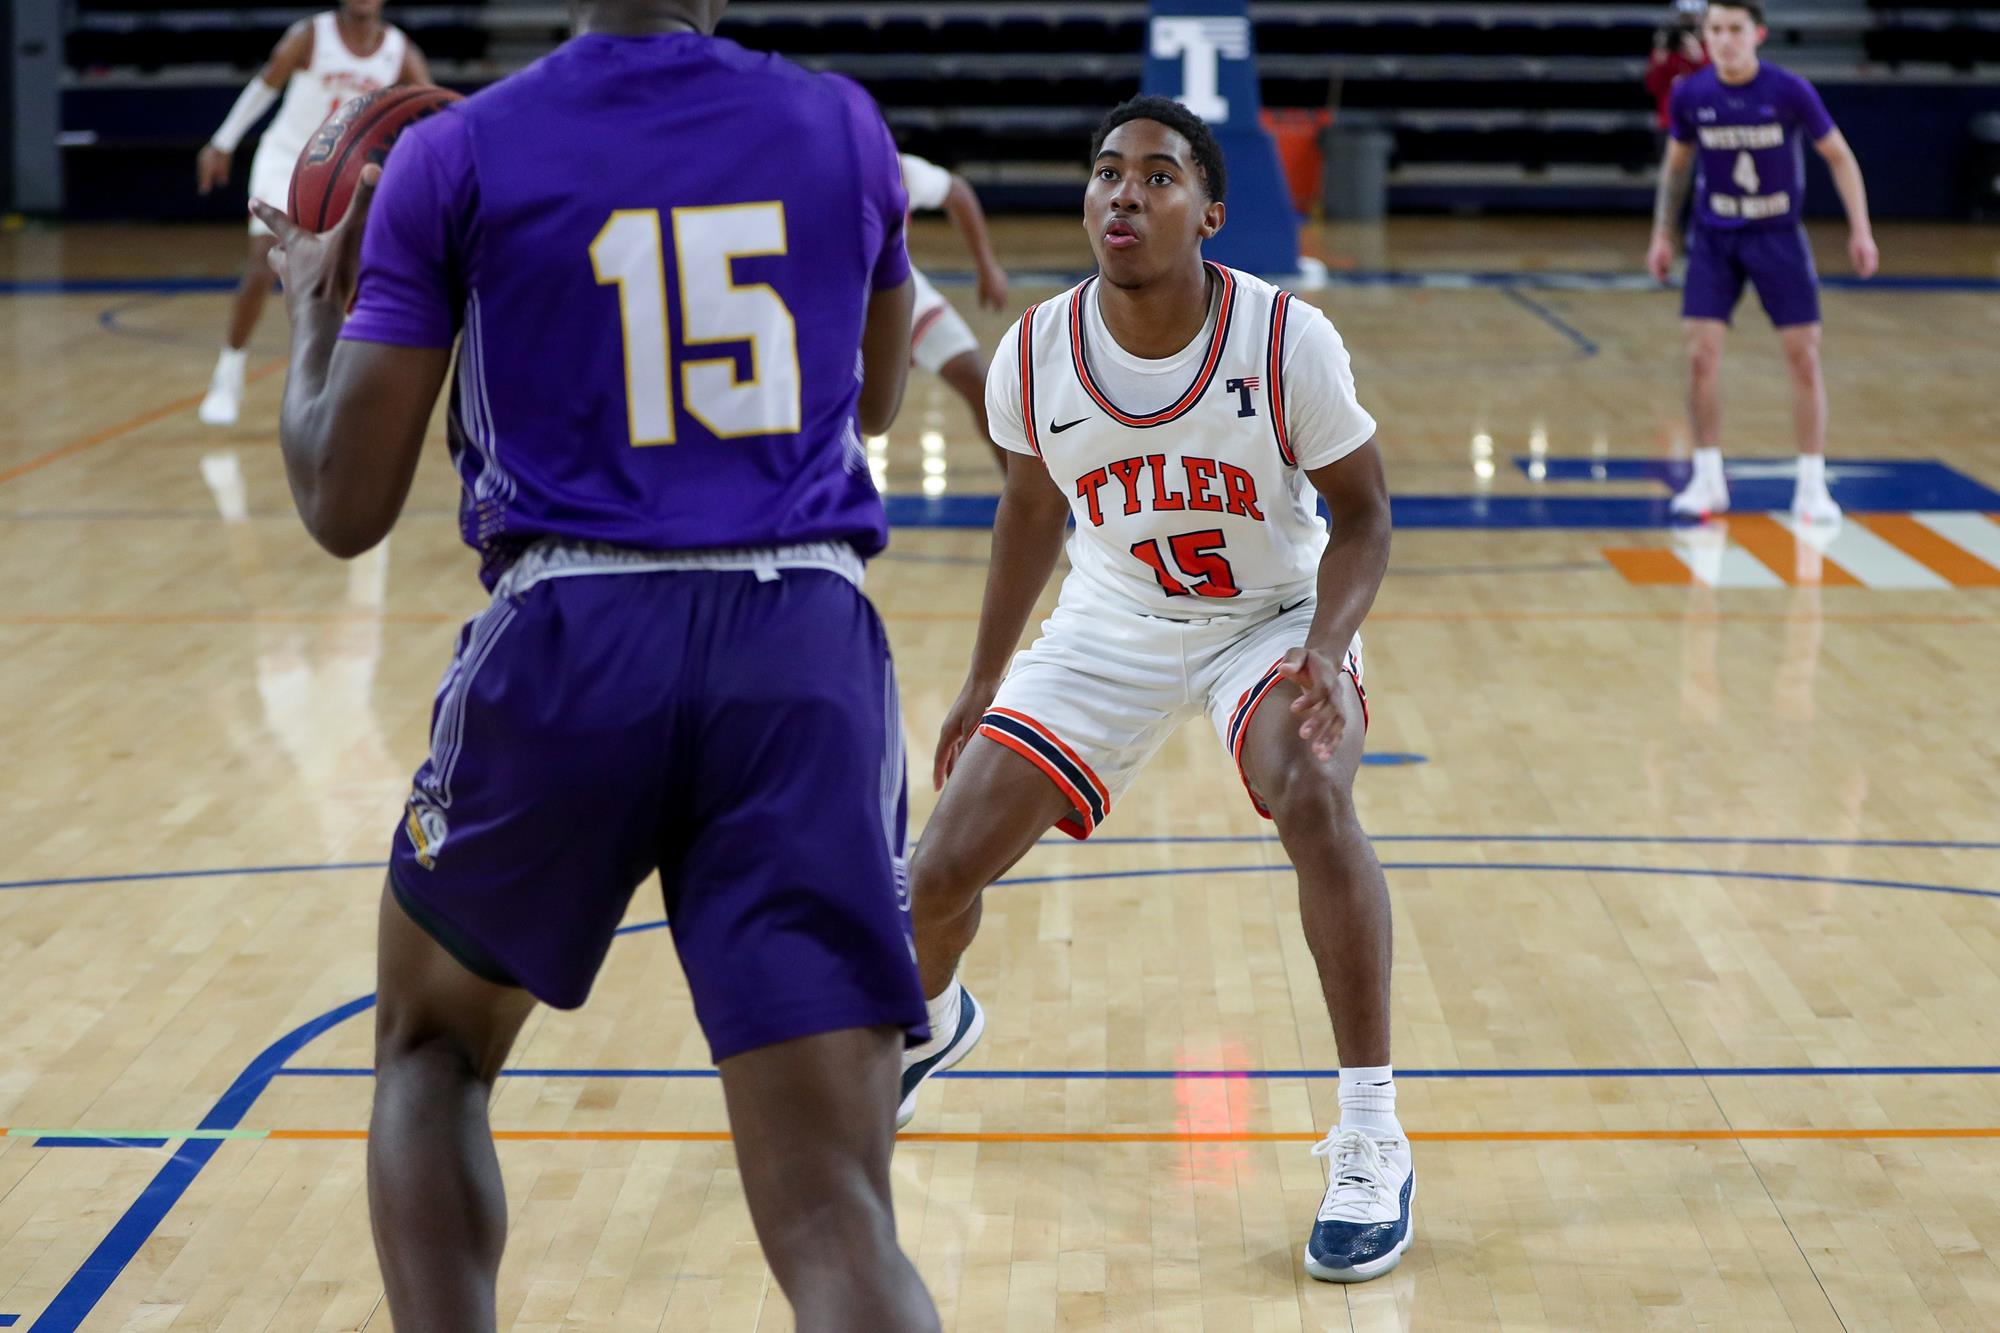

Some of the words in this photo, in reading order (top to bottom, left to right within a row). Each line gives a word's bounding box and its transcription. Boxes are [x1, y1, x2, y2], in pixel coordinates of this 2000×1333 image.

[1151, 16, 1249, 124] T
[1733, 150, 1760, 193] 4
[588, 201, 801, 447] 15
[1226, 376, 1260, 418] T
[1076, 454, 1265, 527] TYLER
[1130, 528, 1242, 598] 15
